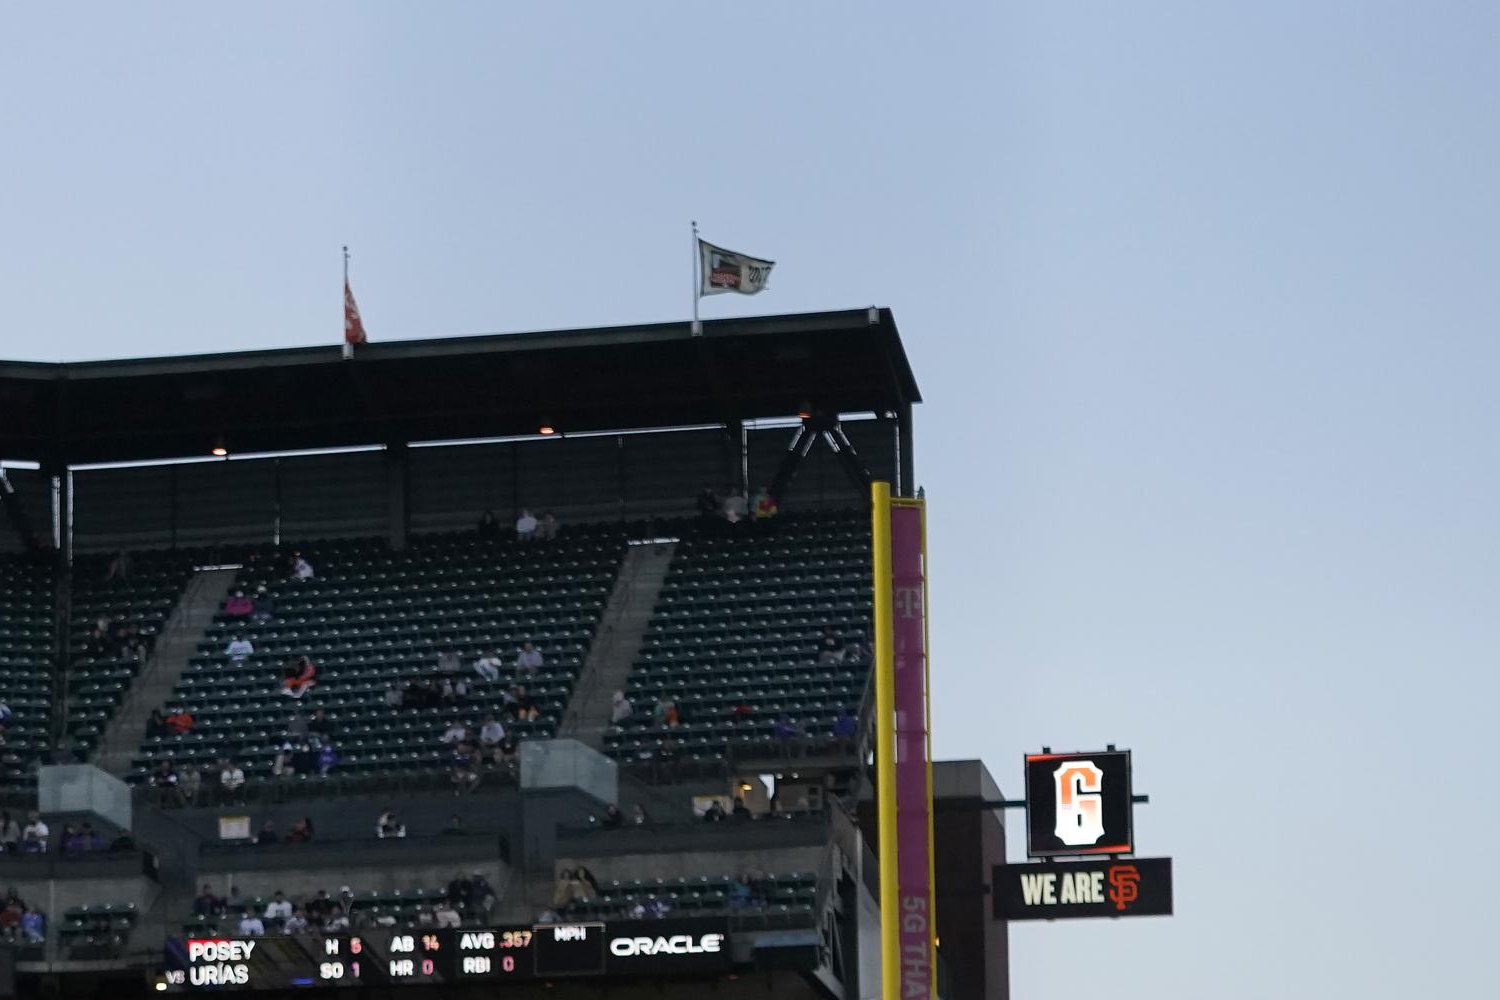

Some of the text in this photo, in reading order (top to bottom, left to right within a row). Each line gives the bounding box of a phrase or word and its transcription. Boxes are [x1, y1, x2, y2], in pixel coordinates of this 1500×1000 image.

[1020, 873, 1057, 905] WE
[1061, 871, 1105, 904] ARE
[903, 896, 927, 933] 5G
[188, 940, 255, 962] POSEY
[325, 938, 339, 955] H
[390, 935, 414, 952] AB
[460, 932, 495, 949] AVG
[554, 926, 586, 942] MPH
[610, 934, 720, 956] ORACLE
[190, 962, 248, 986] URÍAS
[320, 962, 344, 979] SO
[351, 962, 360, 977] 1
[389, 959, 414, 976] HR
[422, 959, 434, 975] 0
[463, 957, 491, 973] RBI
[503, 956, 514, 971] 0
